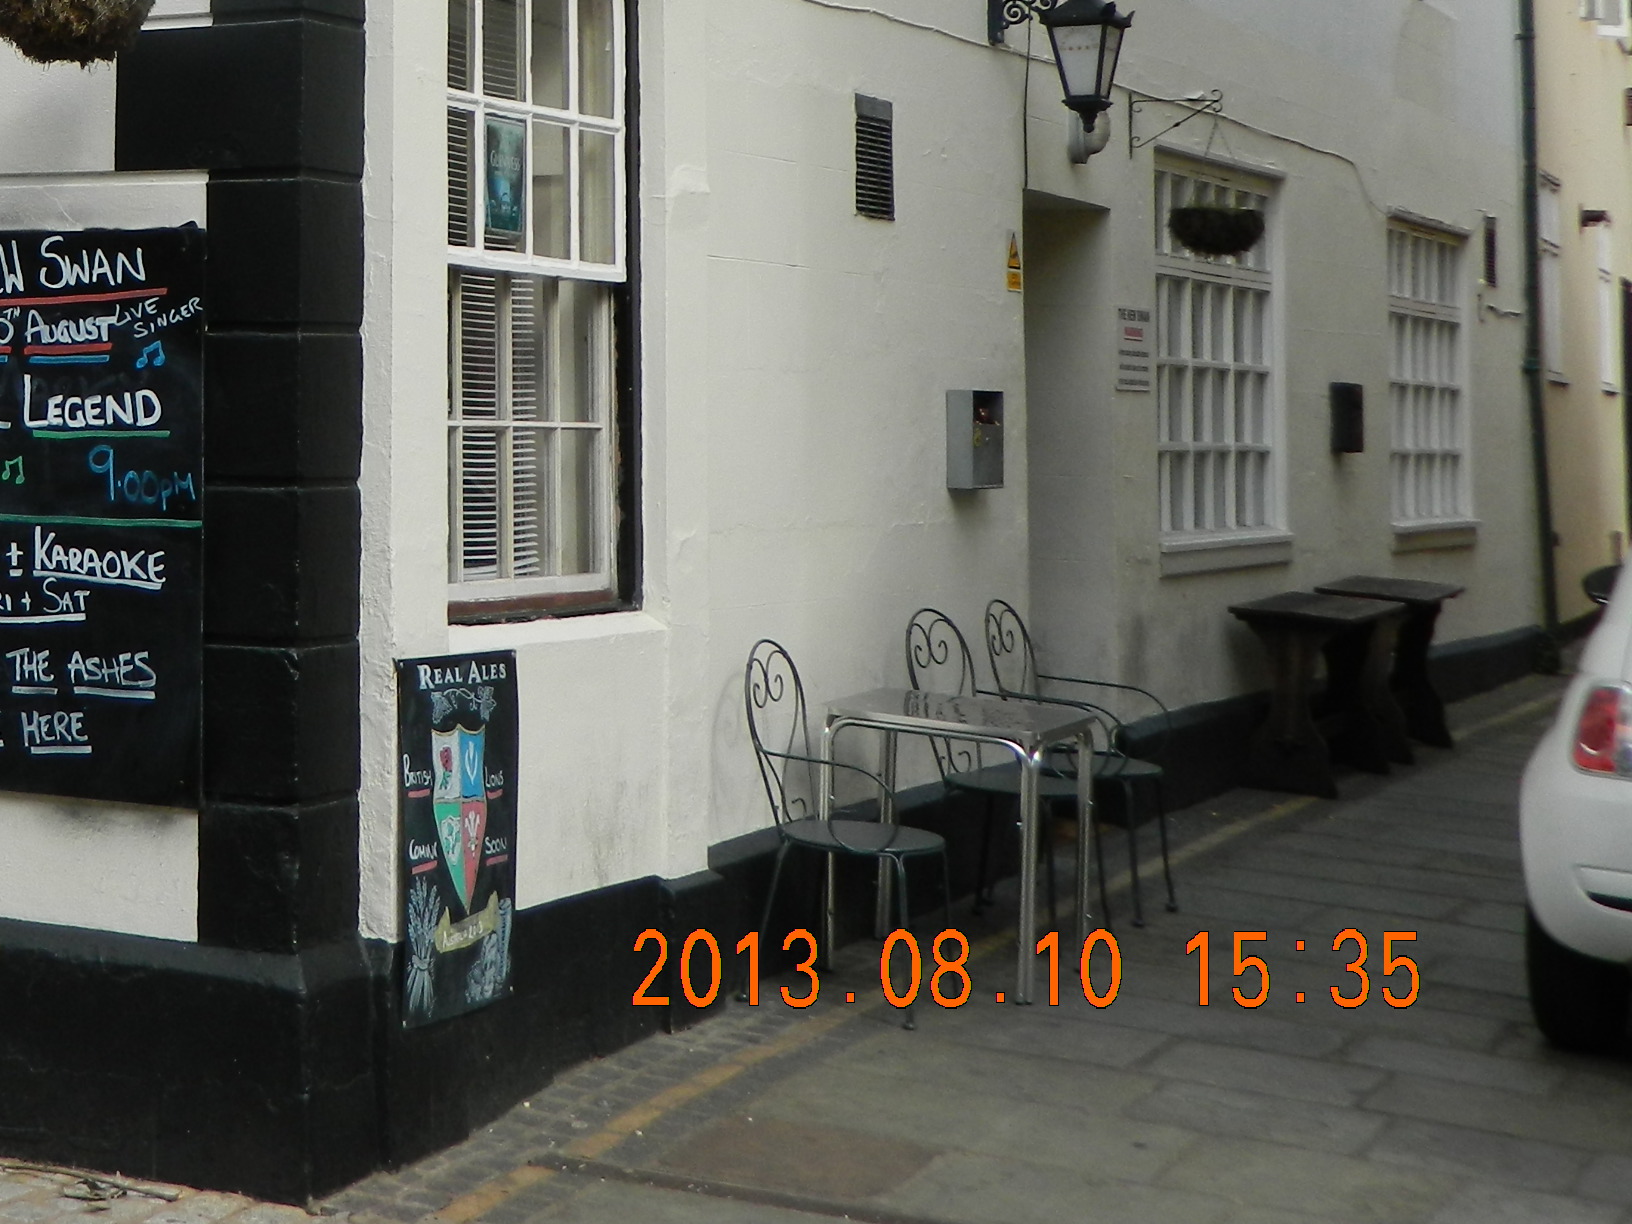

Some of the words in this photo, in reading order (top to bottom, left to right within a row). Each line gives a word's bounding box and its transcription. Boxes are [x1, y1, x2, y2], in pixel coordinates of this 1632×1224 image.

[40, 236, 146, 289] SWAN
[24, 309, 116, 344] AUGUST
[115, 297, 161, 326] LIVE
[134, 296, 204, 338] SINGER
[23, 374, 162, 428] LEGEND
[33, 525, 166, 583] KARAOKE
[43, 576, 91, 614] SAT
[5, 647, 55, 683] THE
[68, 651, 157, 688] ASHES
[418, 662, 463, 691] REAL
[467, 660, 508, 684] ALES
[20, 709, 89, 747] HERE
